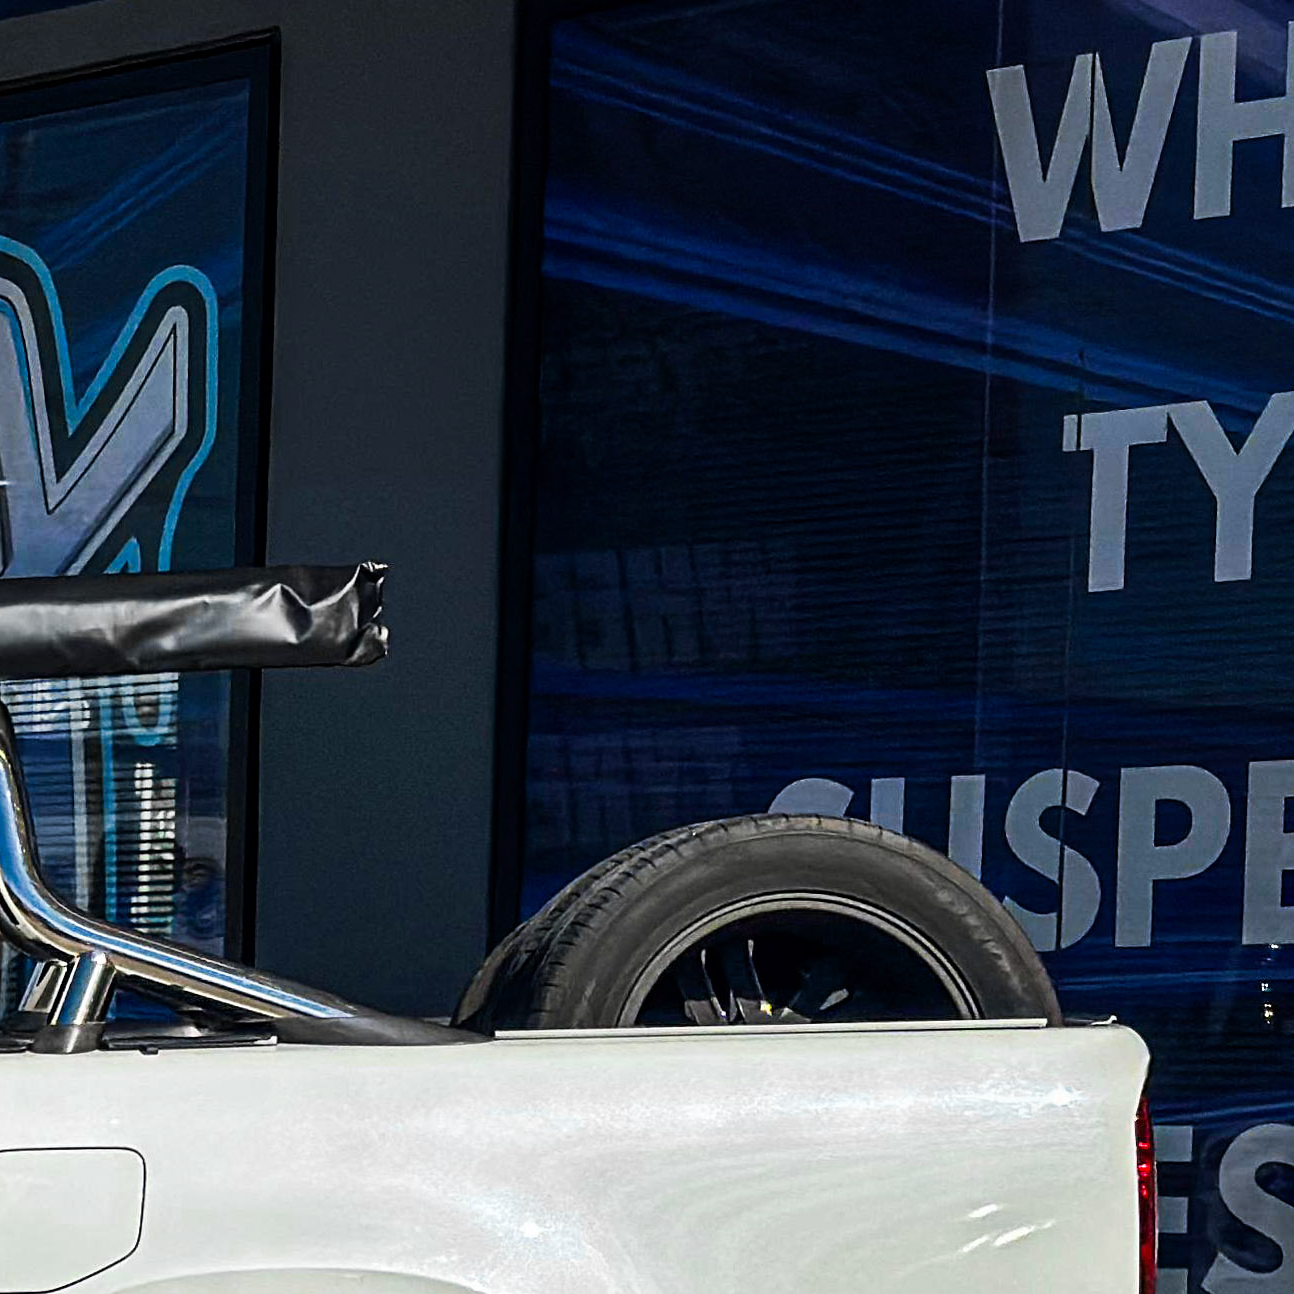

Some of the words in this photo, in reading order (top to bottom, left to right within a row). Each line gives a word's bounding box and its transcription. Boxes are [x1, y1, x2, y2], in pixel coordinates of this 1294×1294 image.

[987, 22, 1294, 243] WH
[1063, 391, 1294, 592] TY
[768, 760, 1294, 952] SPE
